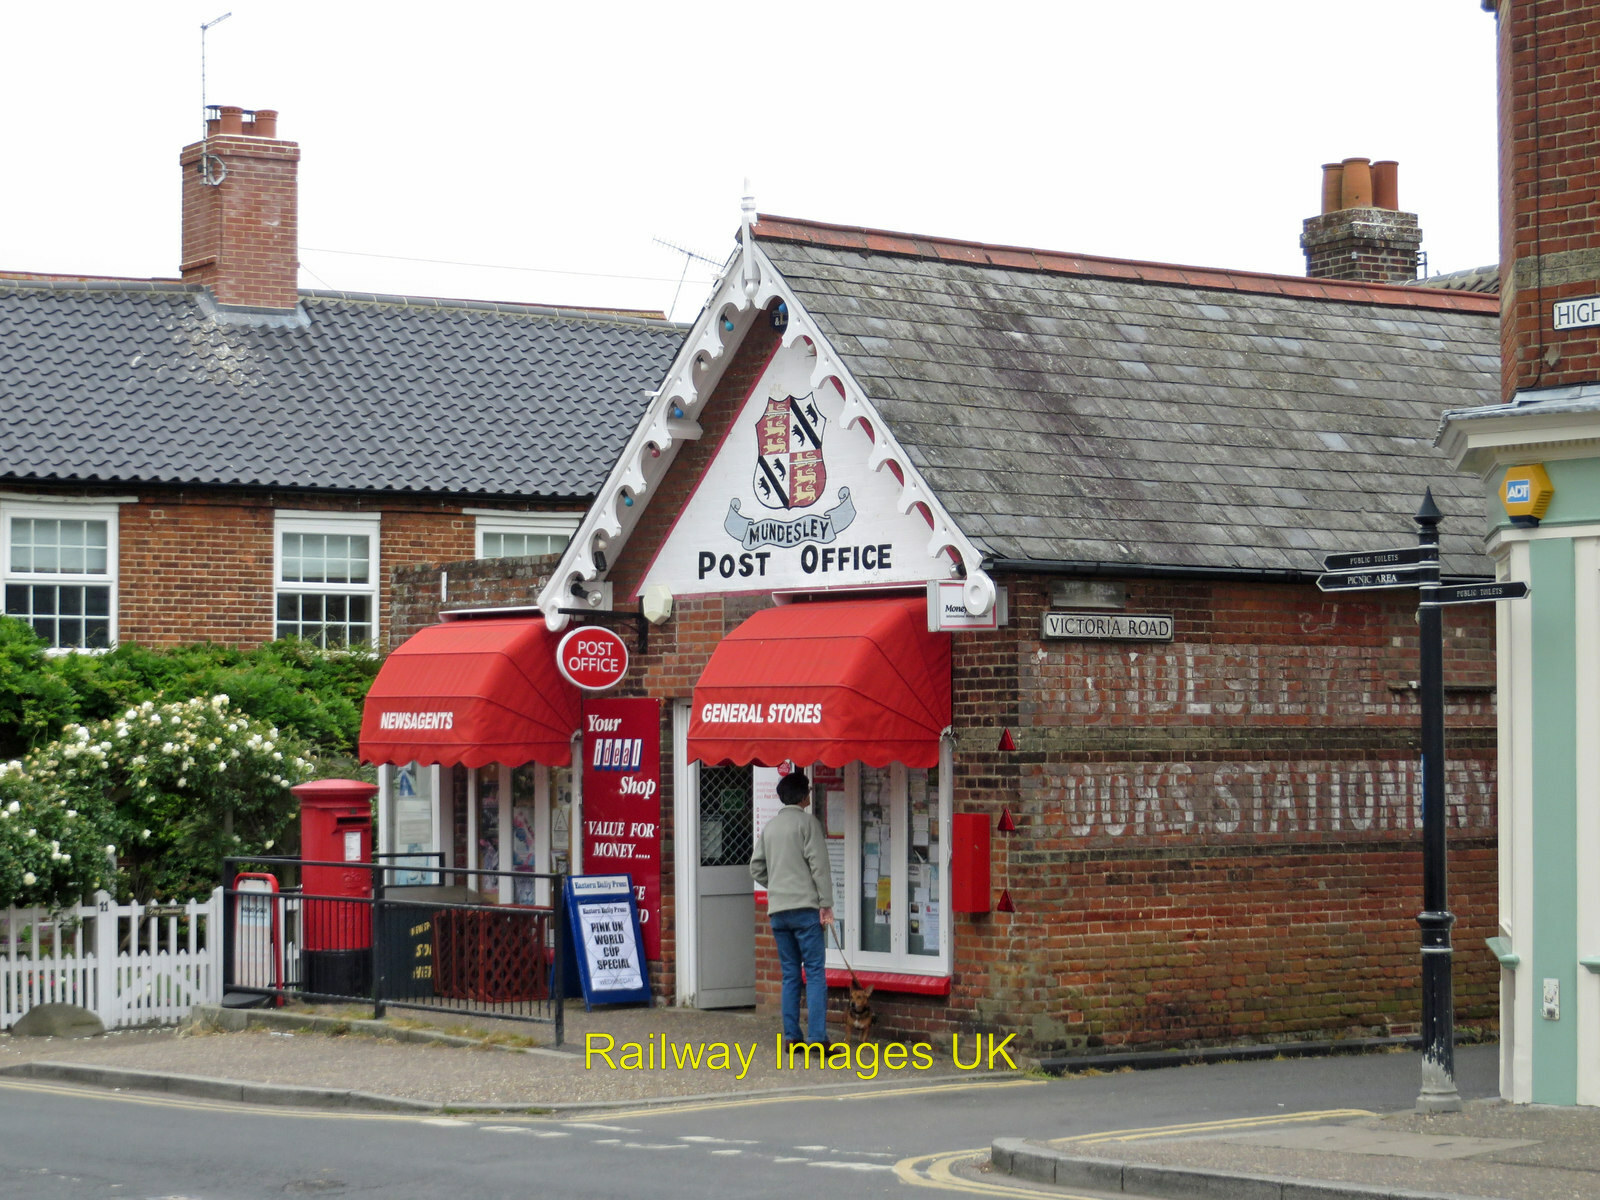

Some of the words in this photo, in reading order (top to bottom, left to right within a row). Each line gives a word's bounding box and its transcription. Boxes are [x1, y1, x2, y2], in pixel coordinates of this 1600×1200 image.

[1507, 484, 1529, 498] ADT
[749, 518, 830, 545] MUNDESLEY
[698, 551, 771, 579] POST
[801, 544, 893, 574] OFFICE
[1350, 556, 1371, 565] PUBLIC
[1374, 554, 1399, 562] TOILETS
[1347, 575, 1372, 585] PICNIC
[1375, 574, 1398, 583] AREA
[1050, 617, 1121, 635] VICTORIA
[1128, 619, 1169, 636] ROAD
[578, 640, 614, 656] POST
[568, 656, 619, 673] OFFICE
[380, 711, 454, 730] NEWSAGENTS
[701, 703, 763, 724] GENERAL
[767, 703, 822, 724] STORES
[587, 714, 622, 732] Your
[593, 738, 643, 768] ideal
[619, 776, 656, 799] Shop
[1213, 760, 1494, 833] STATIONRY
[588, 820, 625, 837] VALUE
[630, 822, 656, 838] FOR
[99, 901, 109, 912] 11
[591, 922, 611, 932] PINK
[612, 921, 624, 931] UN
[594, 934, 624, 945] WORLD
[603, 946, 620, 957] CUP
[597, 958, 631, 970] SPECIAL
